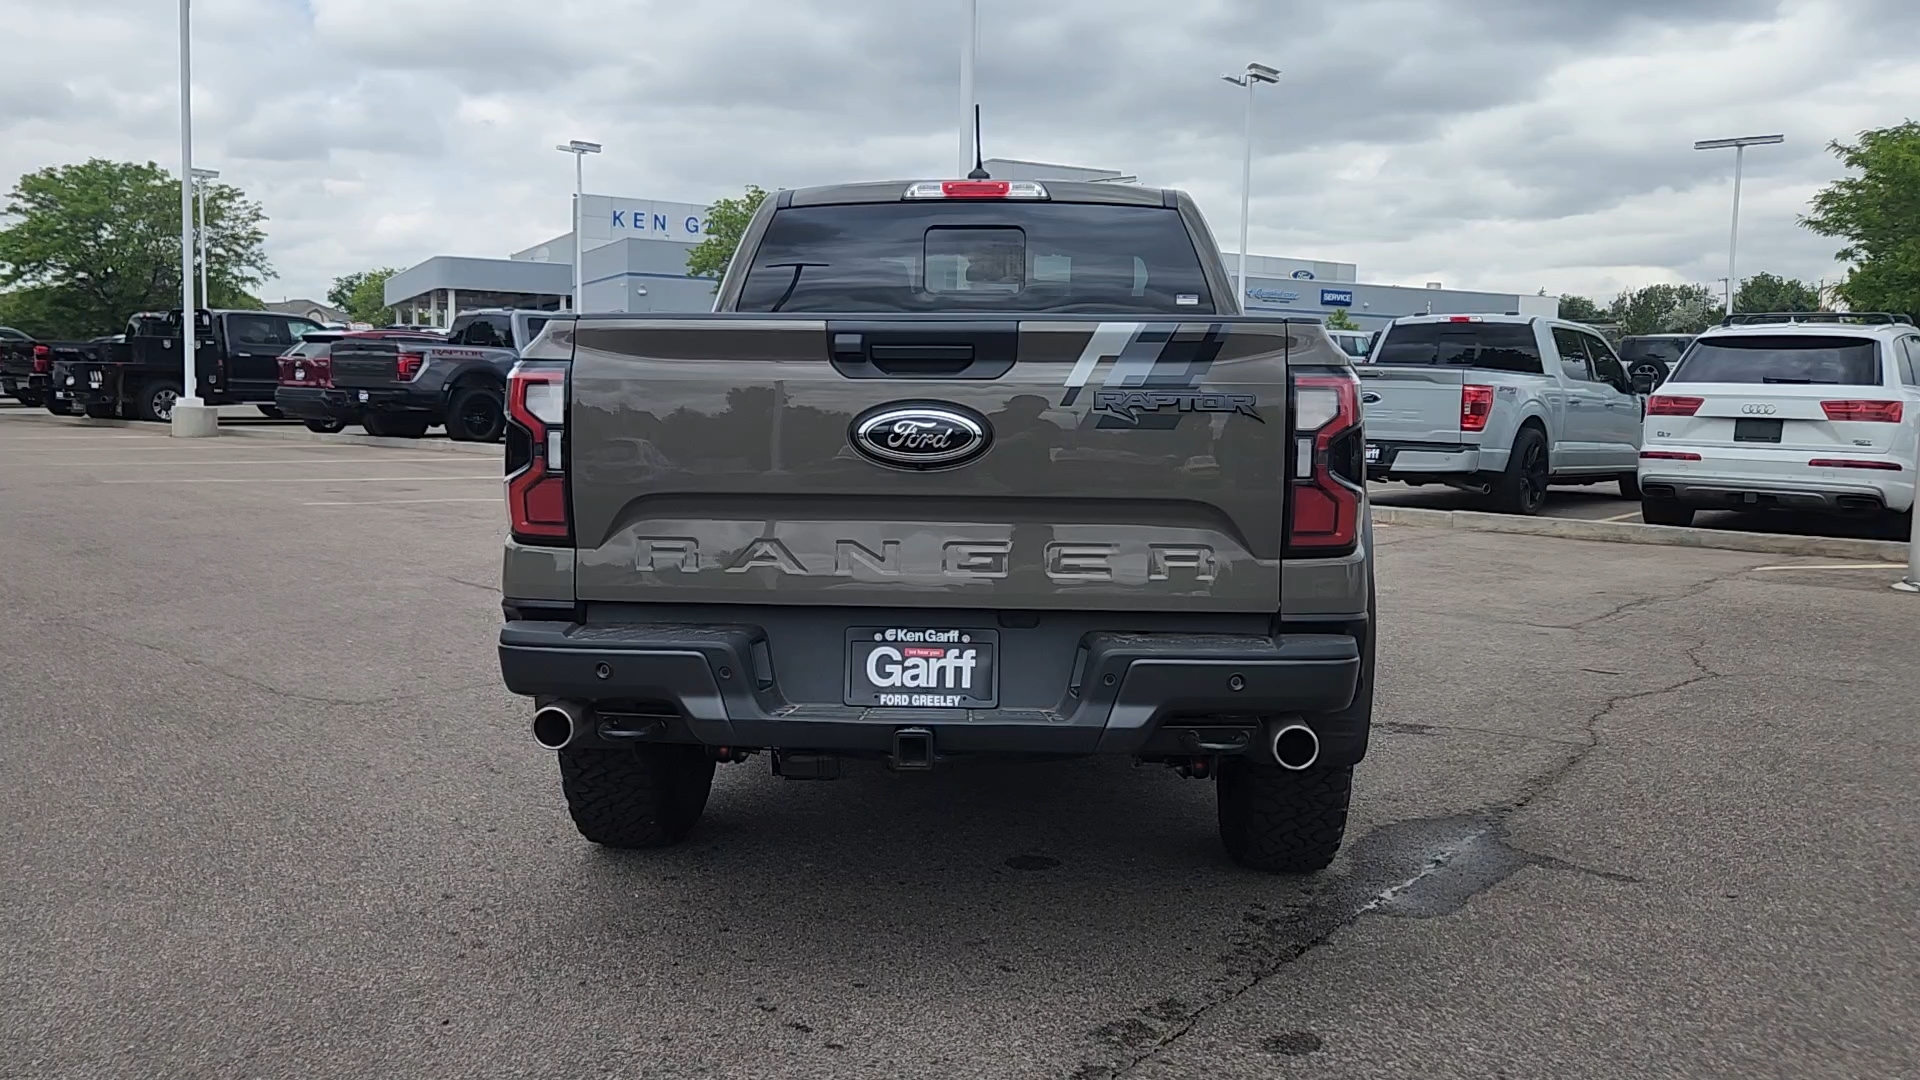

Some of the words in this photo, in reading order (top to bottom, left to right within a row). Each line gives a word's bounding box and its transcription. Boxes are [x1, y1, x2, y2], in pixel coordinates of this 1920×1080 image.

[612, 210, 667, 232] KEN
[1323, 292, 1352, 302] SERVICE
[431, 348, 485, 358] RAPTOR
[1093, 390, 1266, 425] RAPTOR
[887, 420, 953, 449] Ford
[635, 535, 1216, 581] RANGER
[897, 629, 924, 642] Ken
[925, 629, 960, 643] Garff
[866, 646, 976, 689] Garff
[880, 694, 909, 706] FORD
[911, 695, 962, 707] GREELEY
